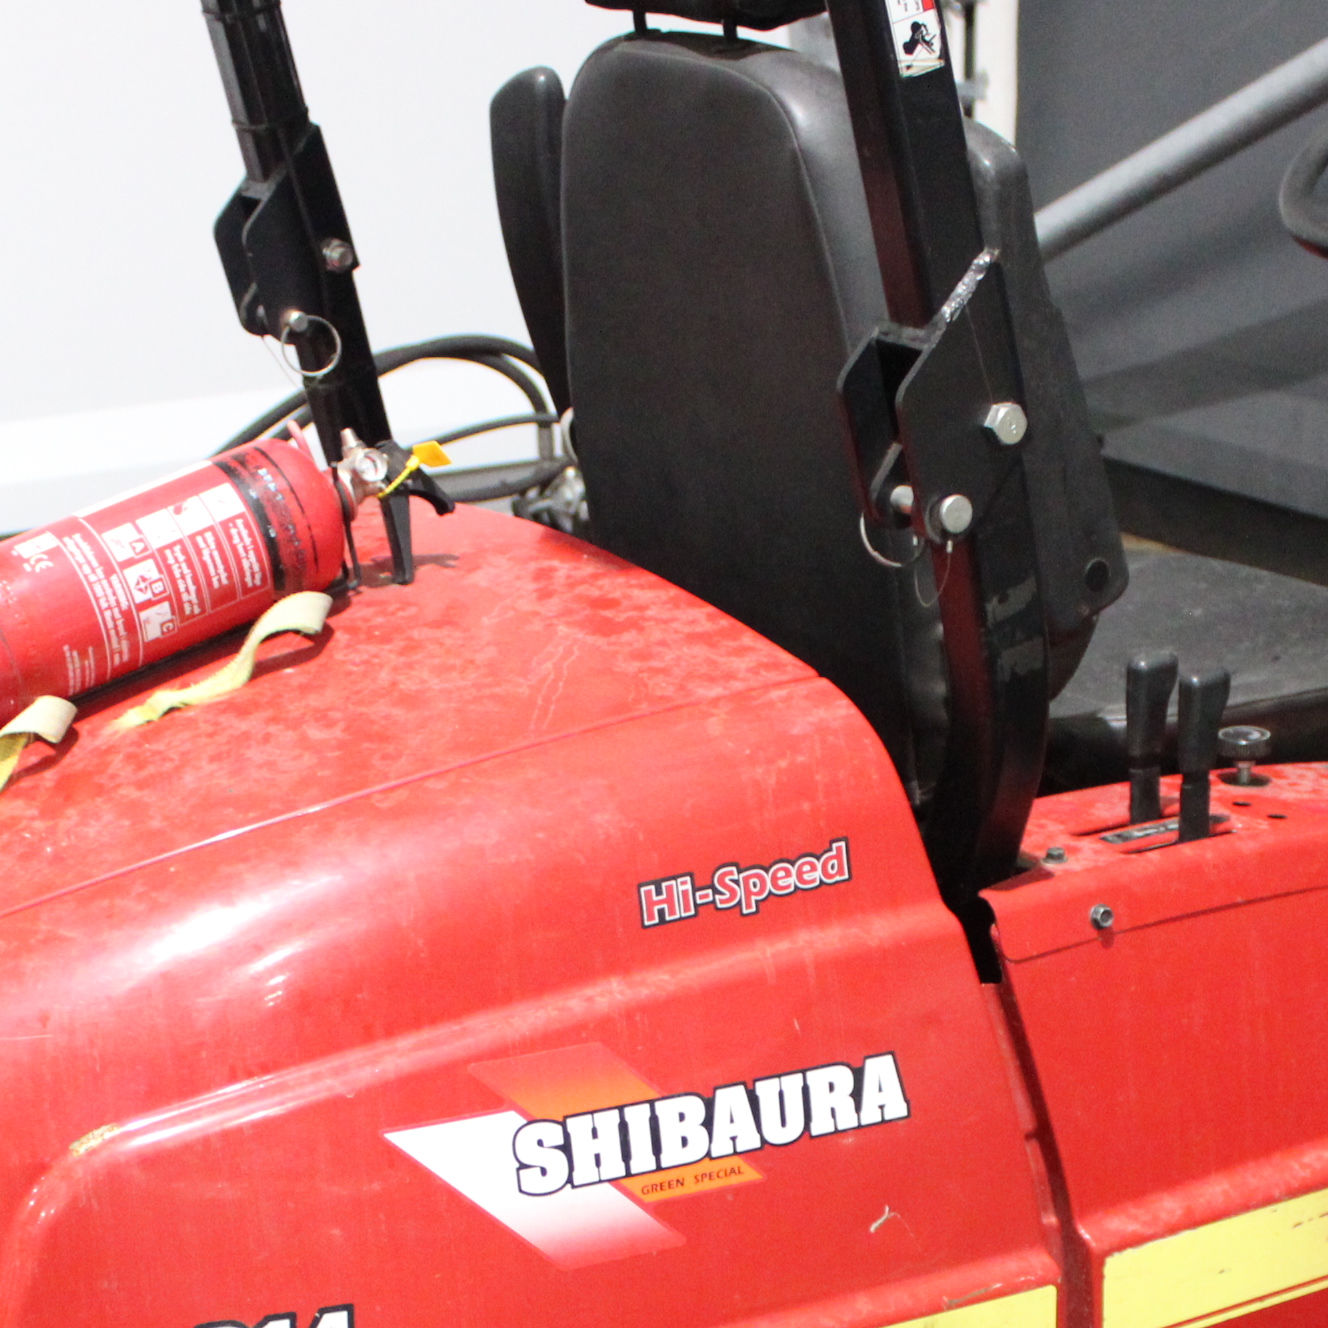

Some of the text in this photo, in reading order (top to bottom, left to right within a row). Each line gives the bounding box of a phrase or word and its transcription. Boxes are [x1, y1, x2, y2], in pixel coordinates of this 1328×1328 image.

[129, 539, 146, 554] A
[149, 579, 164, 595] B
[160, 619, 175, 634] C
[640, 837, 850, 926] Hi-Speed
[512, 1052, 910, 1196] SHIBAURA
[641, 1166, 743, 1195] GREEN SPECIAL
